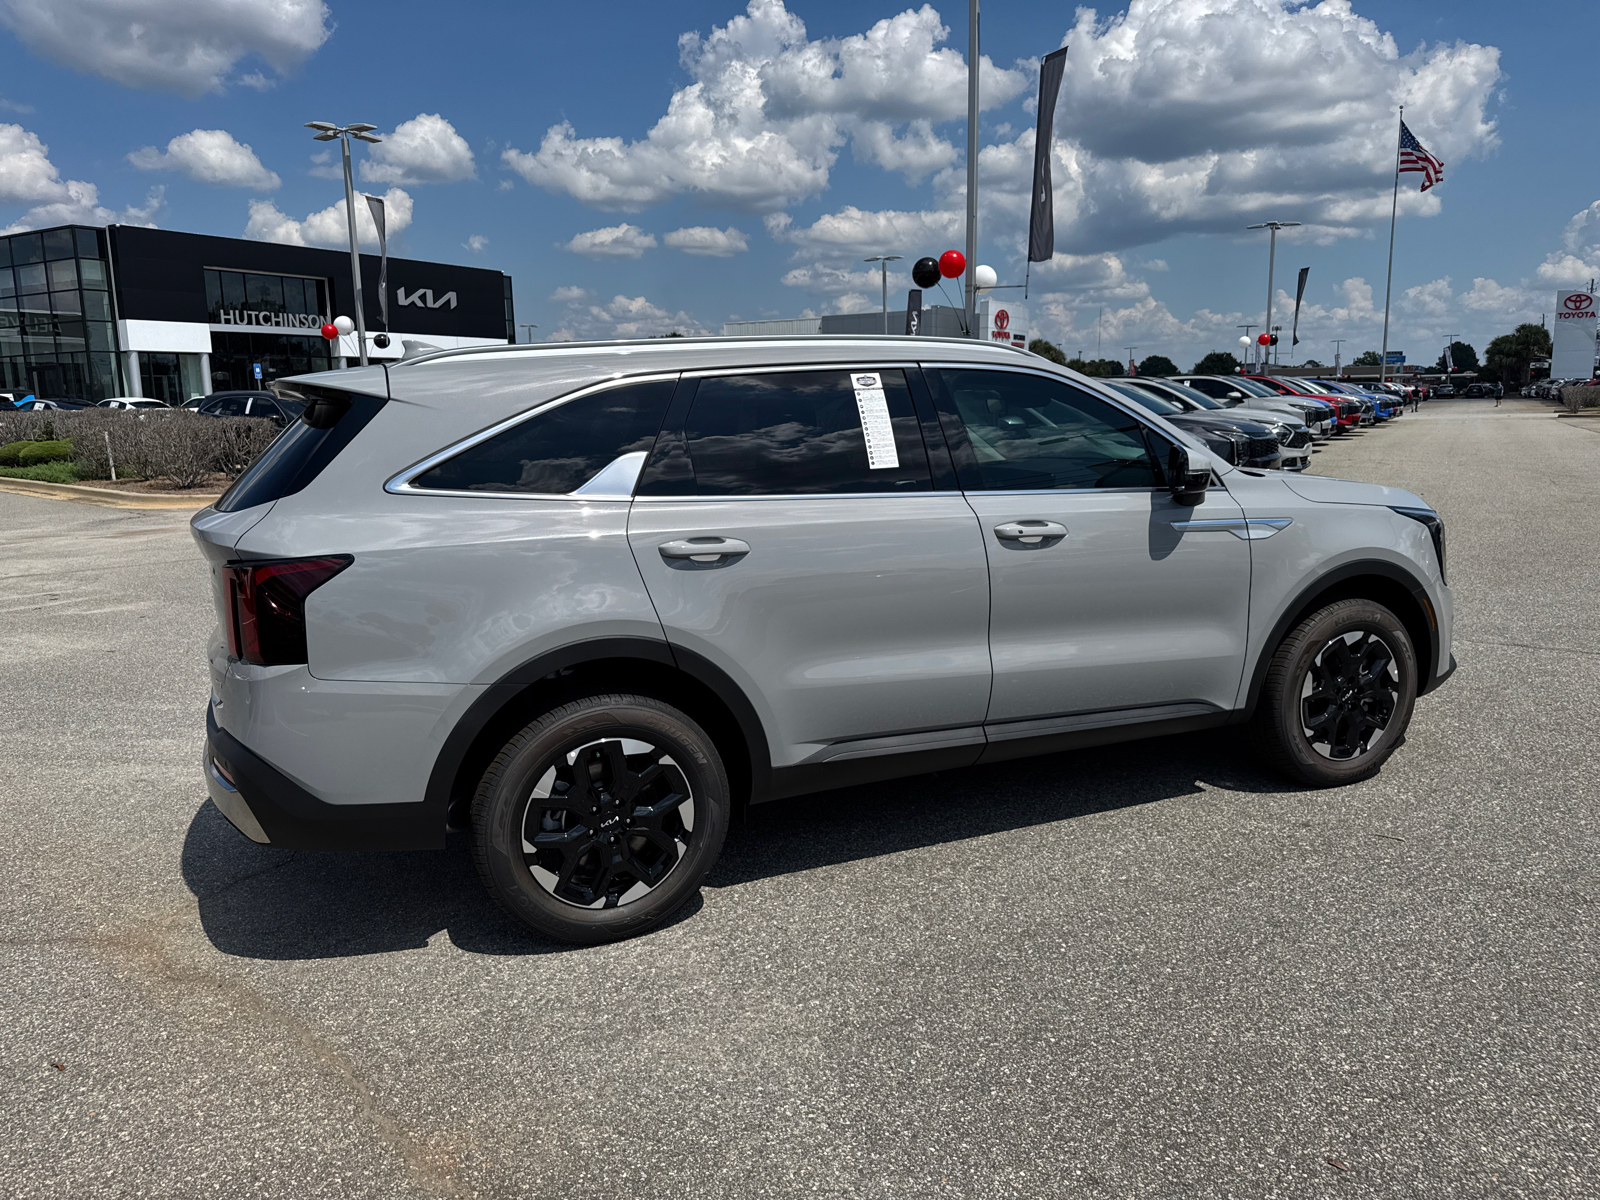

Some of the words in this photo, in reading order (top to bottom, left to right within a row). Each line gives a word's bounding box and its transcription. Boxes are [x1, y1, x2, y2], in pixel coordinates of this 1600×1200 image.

[396, 286, 458, 310] KIA
[1558, 311, 1596, 319] TOYOTA
[643, 716, 708, 765] CRUGEN
